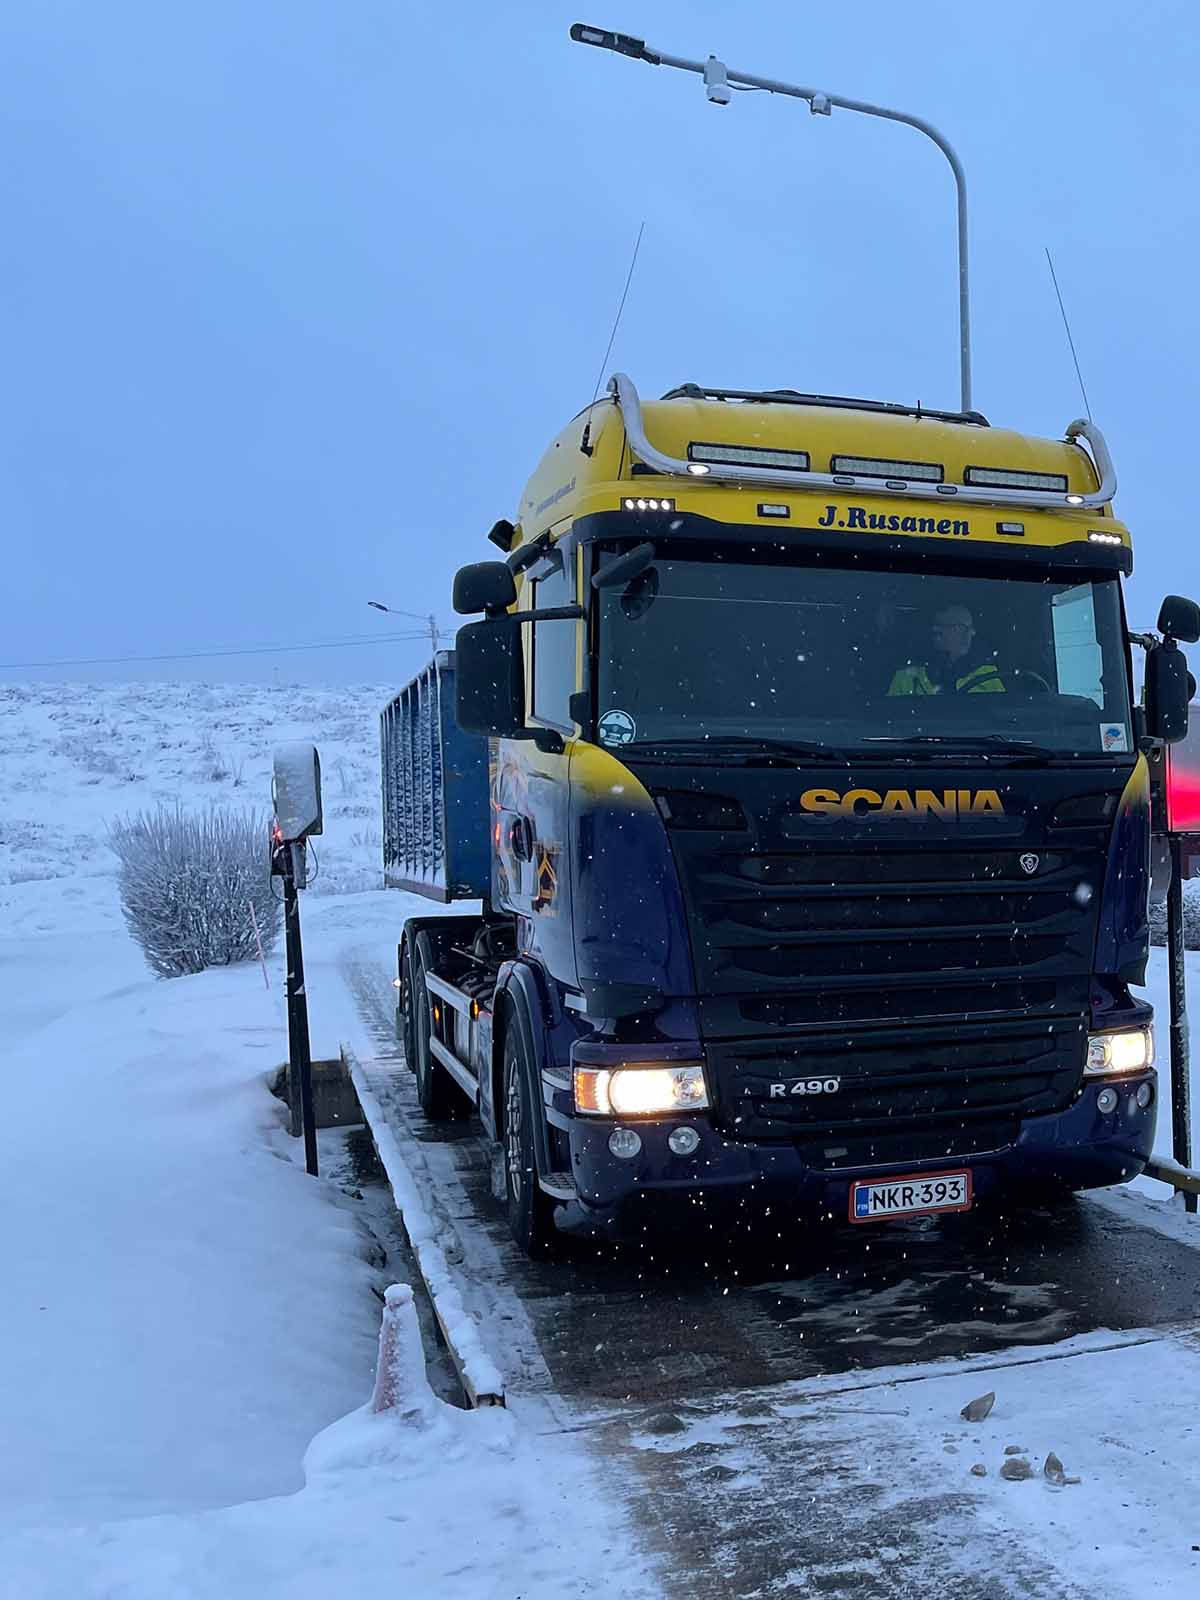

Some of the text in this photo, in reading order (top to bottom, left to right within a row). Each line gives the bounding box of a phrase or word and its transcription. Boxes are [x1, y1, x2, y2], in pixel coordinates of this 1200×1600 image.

[818, 505, 970, 535] J.Rusanen
[799, 788, 1008, 823] SCANIA
[770, 1079, 839, 1098] R 490
[872, 1180, 962, 1210] NKR-393
